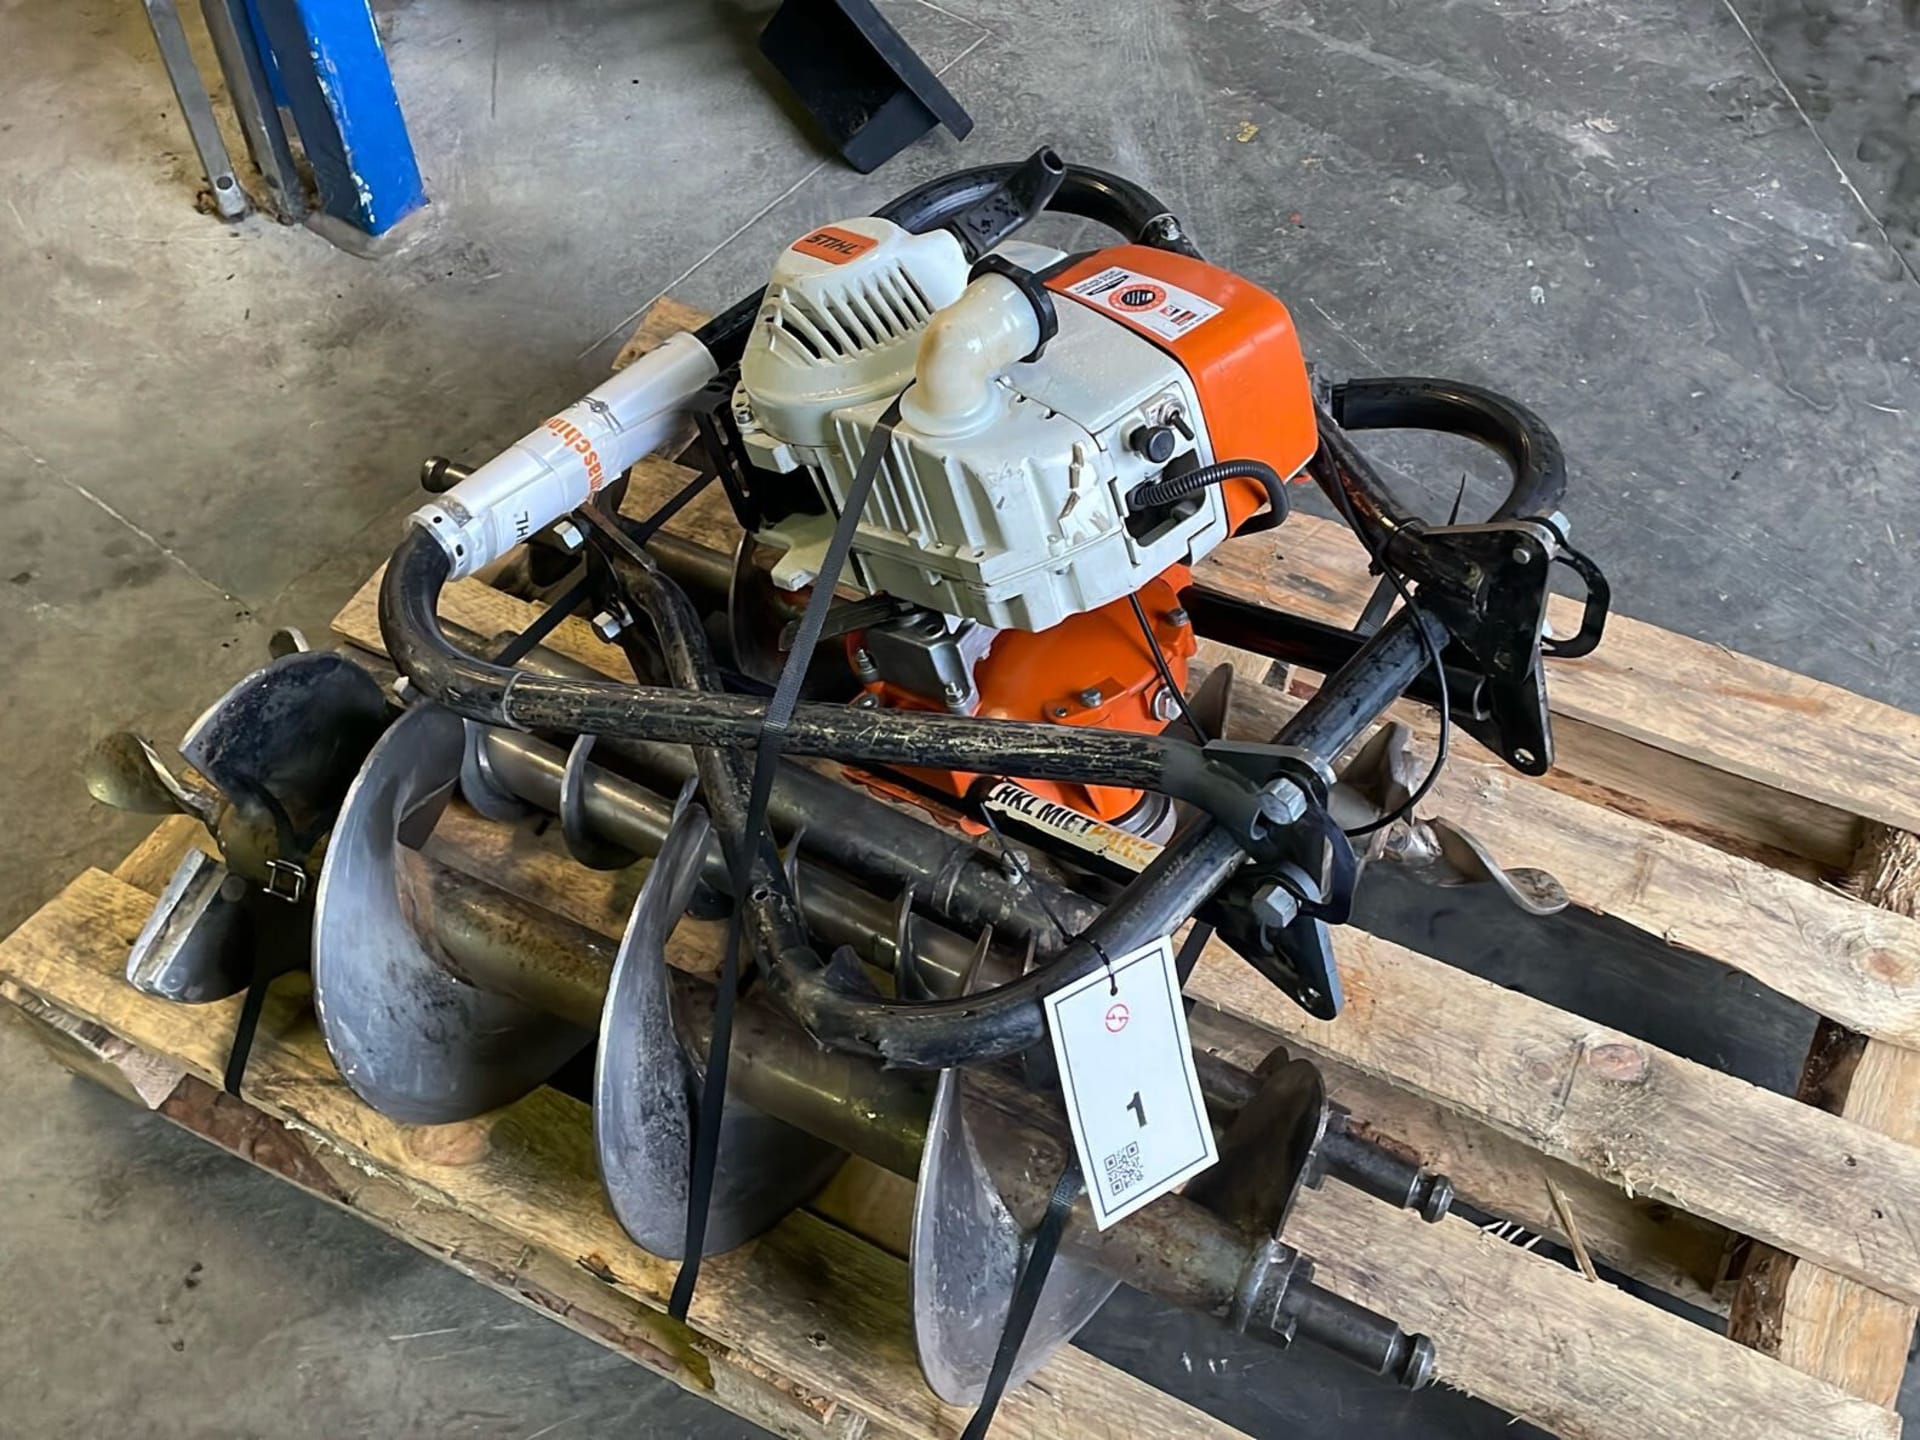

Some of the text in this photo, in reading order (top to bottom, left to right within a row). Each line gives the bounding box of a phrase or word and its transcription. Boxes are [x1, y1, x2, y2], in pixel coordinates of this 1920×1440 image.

[804, 233, 859, 254] STIHL
[994, 784, 1034, 815] HKL
[1126, 1090, 1148, 1129] 1
